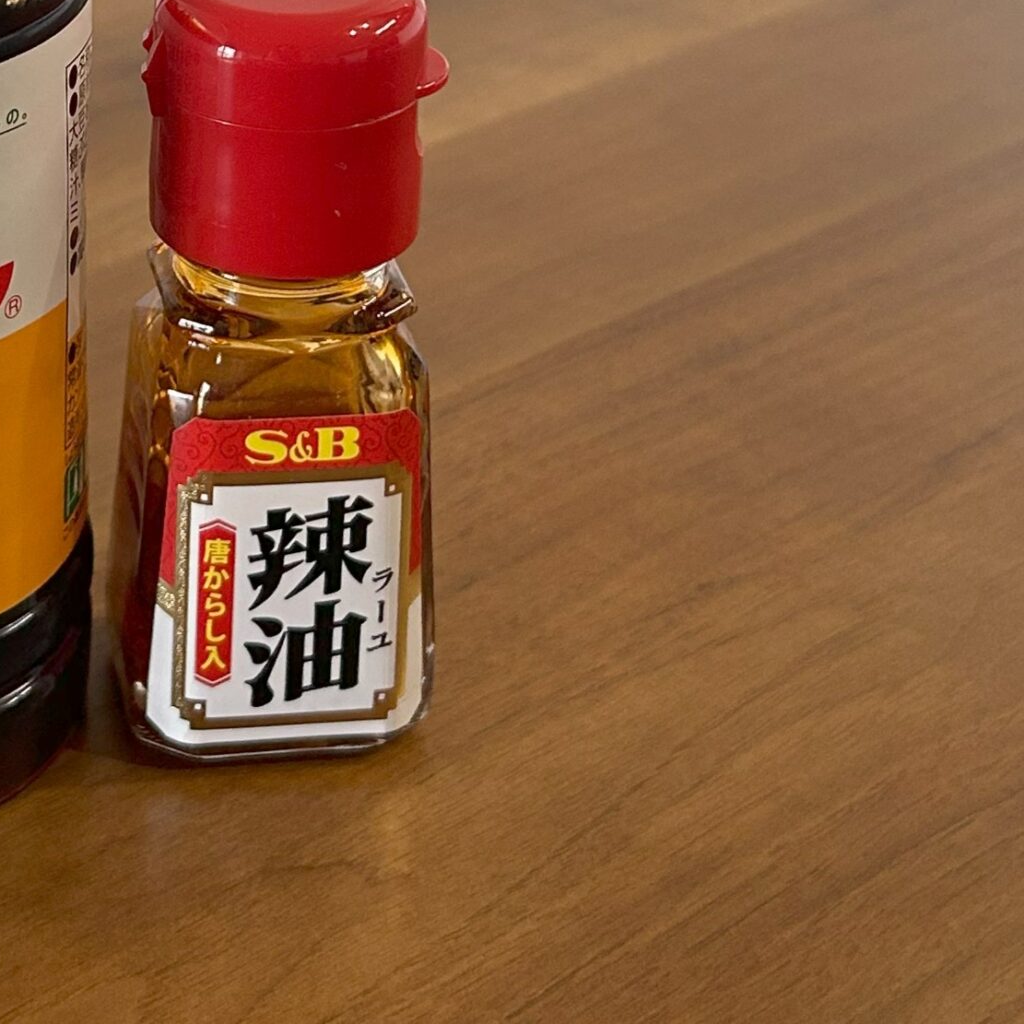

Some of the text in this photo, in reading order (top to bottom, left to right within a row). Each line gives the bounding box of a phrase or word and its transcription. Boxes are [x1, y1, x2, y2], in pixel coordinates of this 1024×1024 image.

[243, 425, 361, 465] S&B
[199, 536, 232, 671] 唐からし入
[243, 494, 375, 708] 辣油
[365, 566, 394, 653] ラーユ
